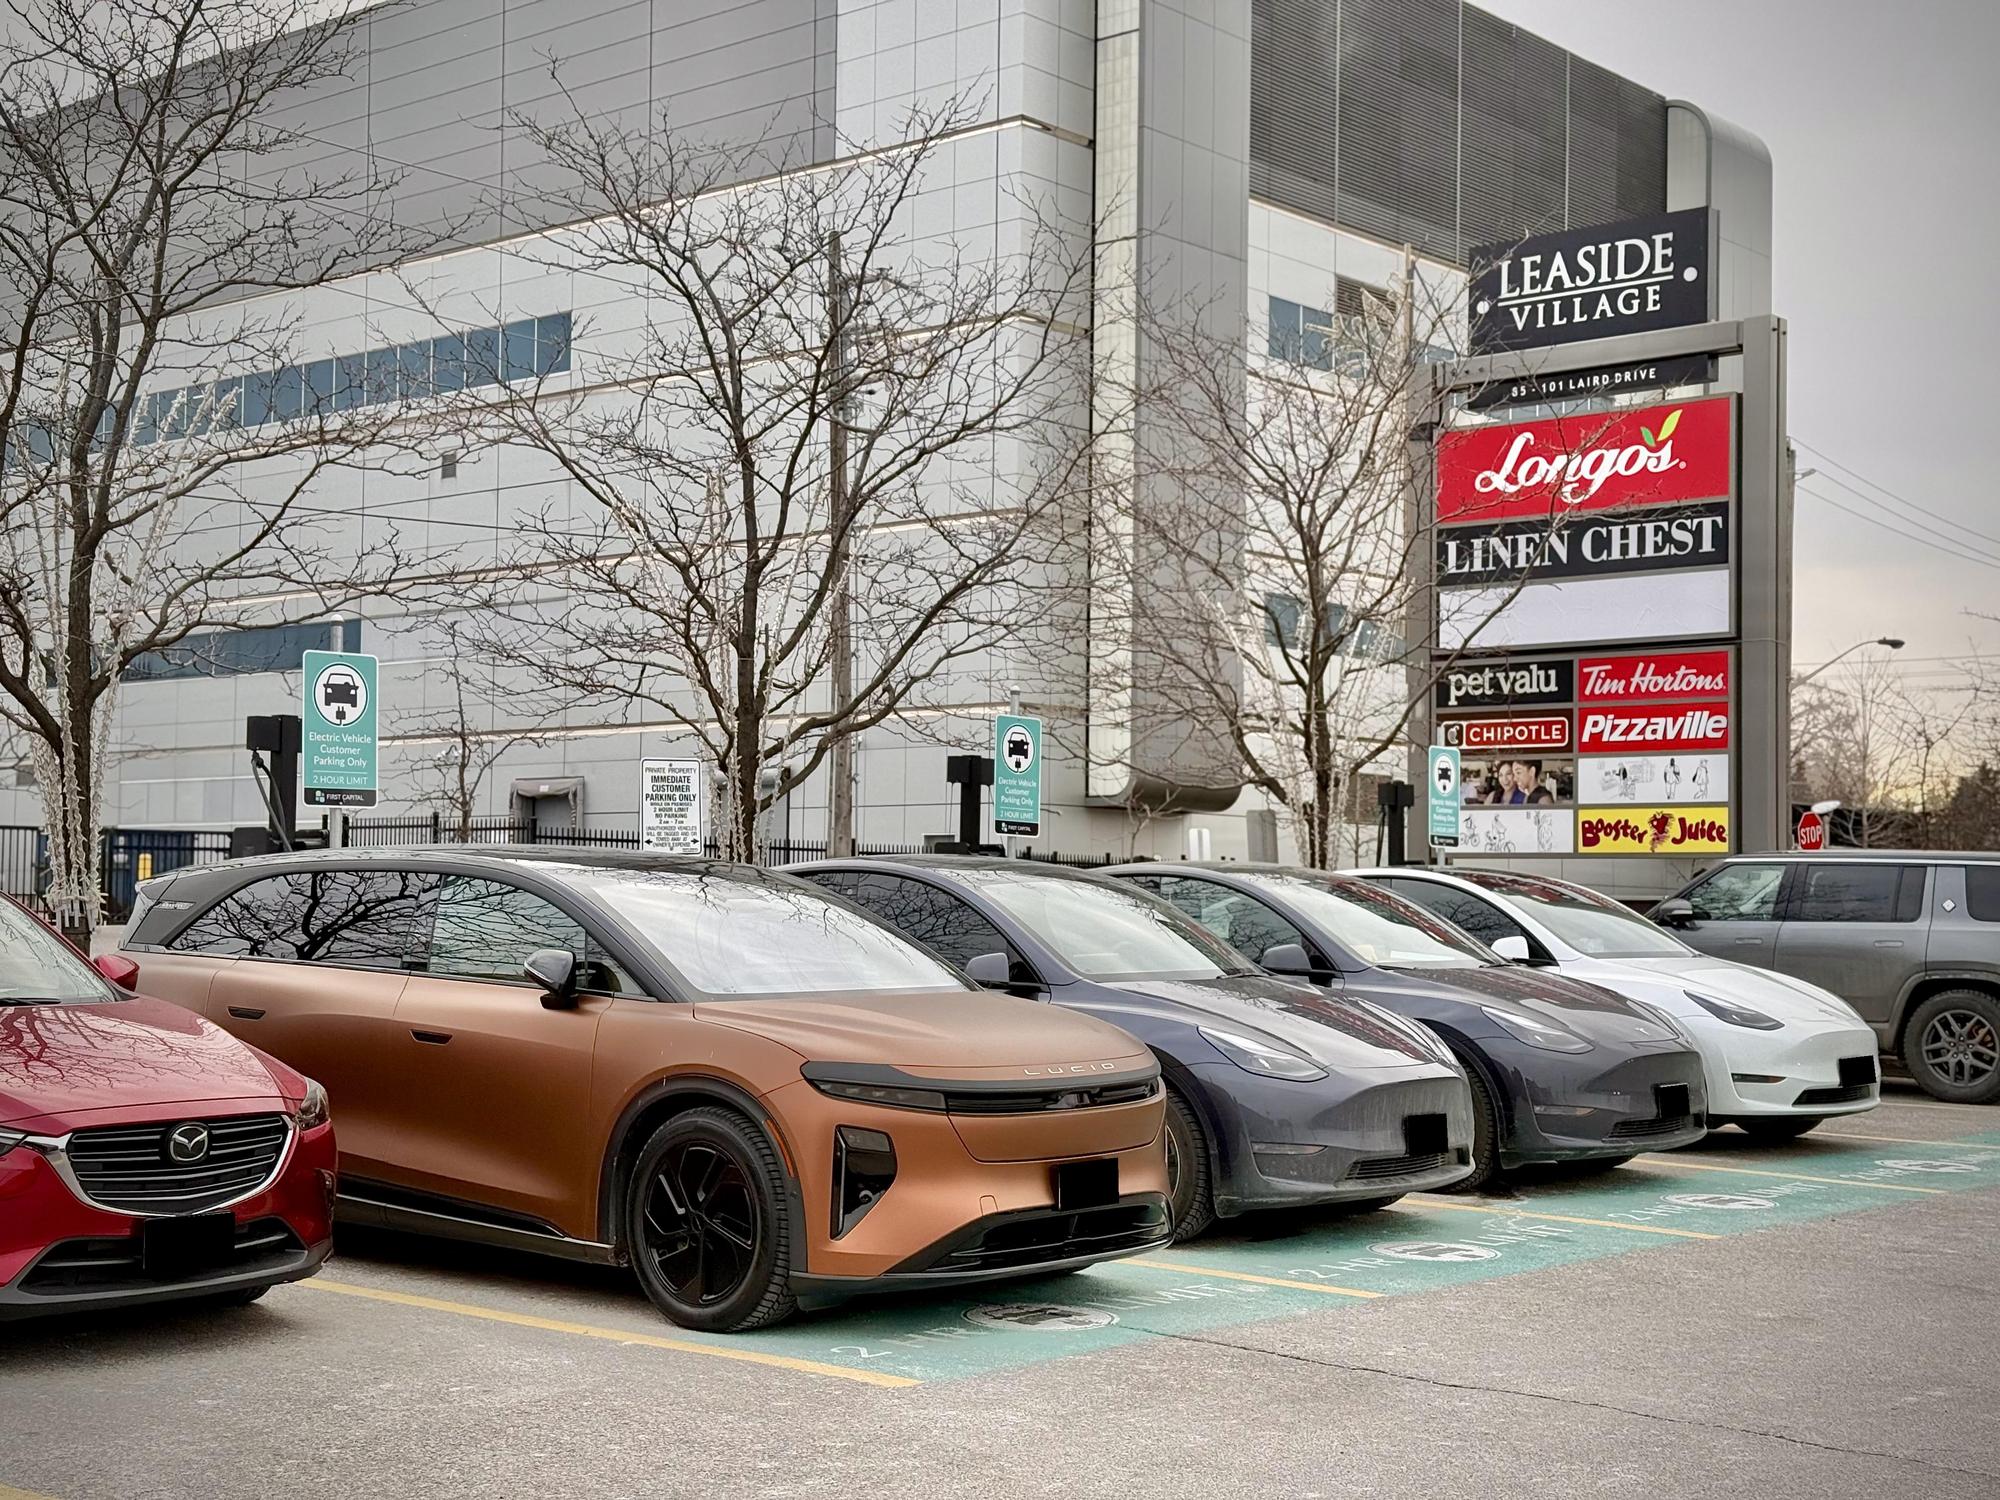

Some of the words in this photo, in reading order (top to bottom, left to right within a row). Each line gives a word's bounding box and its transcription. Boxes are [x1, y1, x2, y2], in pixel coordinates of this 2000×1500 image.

[1499, 232, 1675, 299] LEASIDE
[1509, 285, 1661, 331] VILLAGE
[1541, 381, 1564, 394] 101
[1569, 374, 1609, 390] LAIRD
[1614, 368, 1656, 384] DRIVE
[1445, 529, 1570, 575] LINEN
[1581, 516, 1723, 563] CHEST
[1448, 668, 1494, 706] pet
[1496, 664, 1558, 695] valu
[1583, 664, 1625, 696] Tim
[1630, 662, 1724, 694] Hortons
[1469, 725, 1562, 742] CHIPOTLE
[1581, 710, 1728, 744] Pizzaville
[309, 732, 340, 742] Electric
[342, 733, 372, 744] Vehicle
[320, 744, 361, 754] Customer
[313, 756, 345, 767] Parking
[347, 757, 367, 768] Only
[313, 775, 319, 784] 2
[320, 775, 345, 785] HOUR
[347, 776, 368, 785] LIMIT
[651, 775, 691, 783] IMMEDIATE
[651, 784, 691, 793] CUSTOMER
[645, 793, 677, 802] PARKING
[679, 793, 697, 802] ONLY
[1581, 818, 1648, 848] Booster
[1671, 817, 1727, 845] Juice
[1800, 825, 1821, 845] STOP
[1023, 1062, 1115, 1076] LUCID
[1287, 1269, 1341, 1279] 2
[1319, 1257, 1406, 1271] HR
[830, 1345, 893, 1358] 2
[879, 1326, 992, 1348] HR
